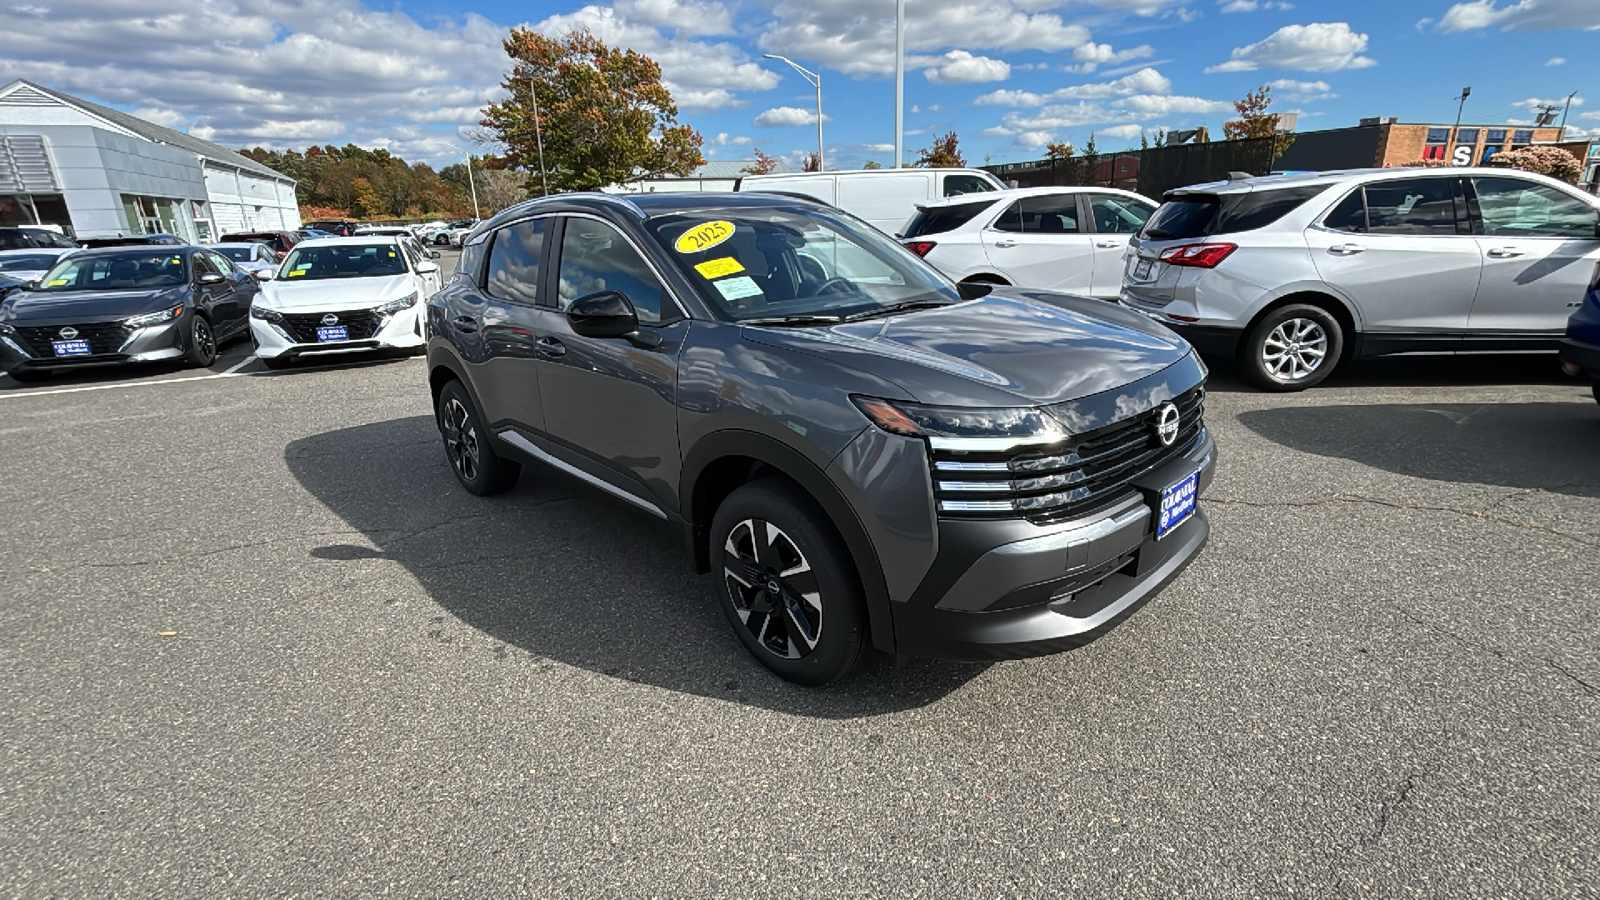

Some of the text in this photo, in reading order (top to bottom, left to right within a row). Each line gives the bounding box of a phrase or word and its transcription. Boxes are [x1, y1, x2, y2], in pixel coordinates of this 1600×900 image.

[688, 223, 727, 248] 2025
[1161, 479, 1197, 513] COLONIAL
[1171, 495, 1194, 519] Medford
